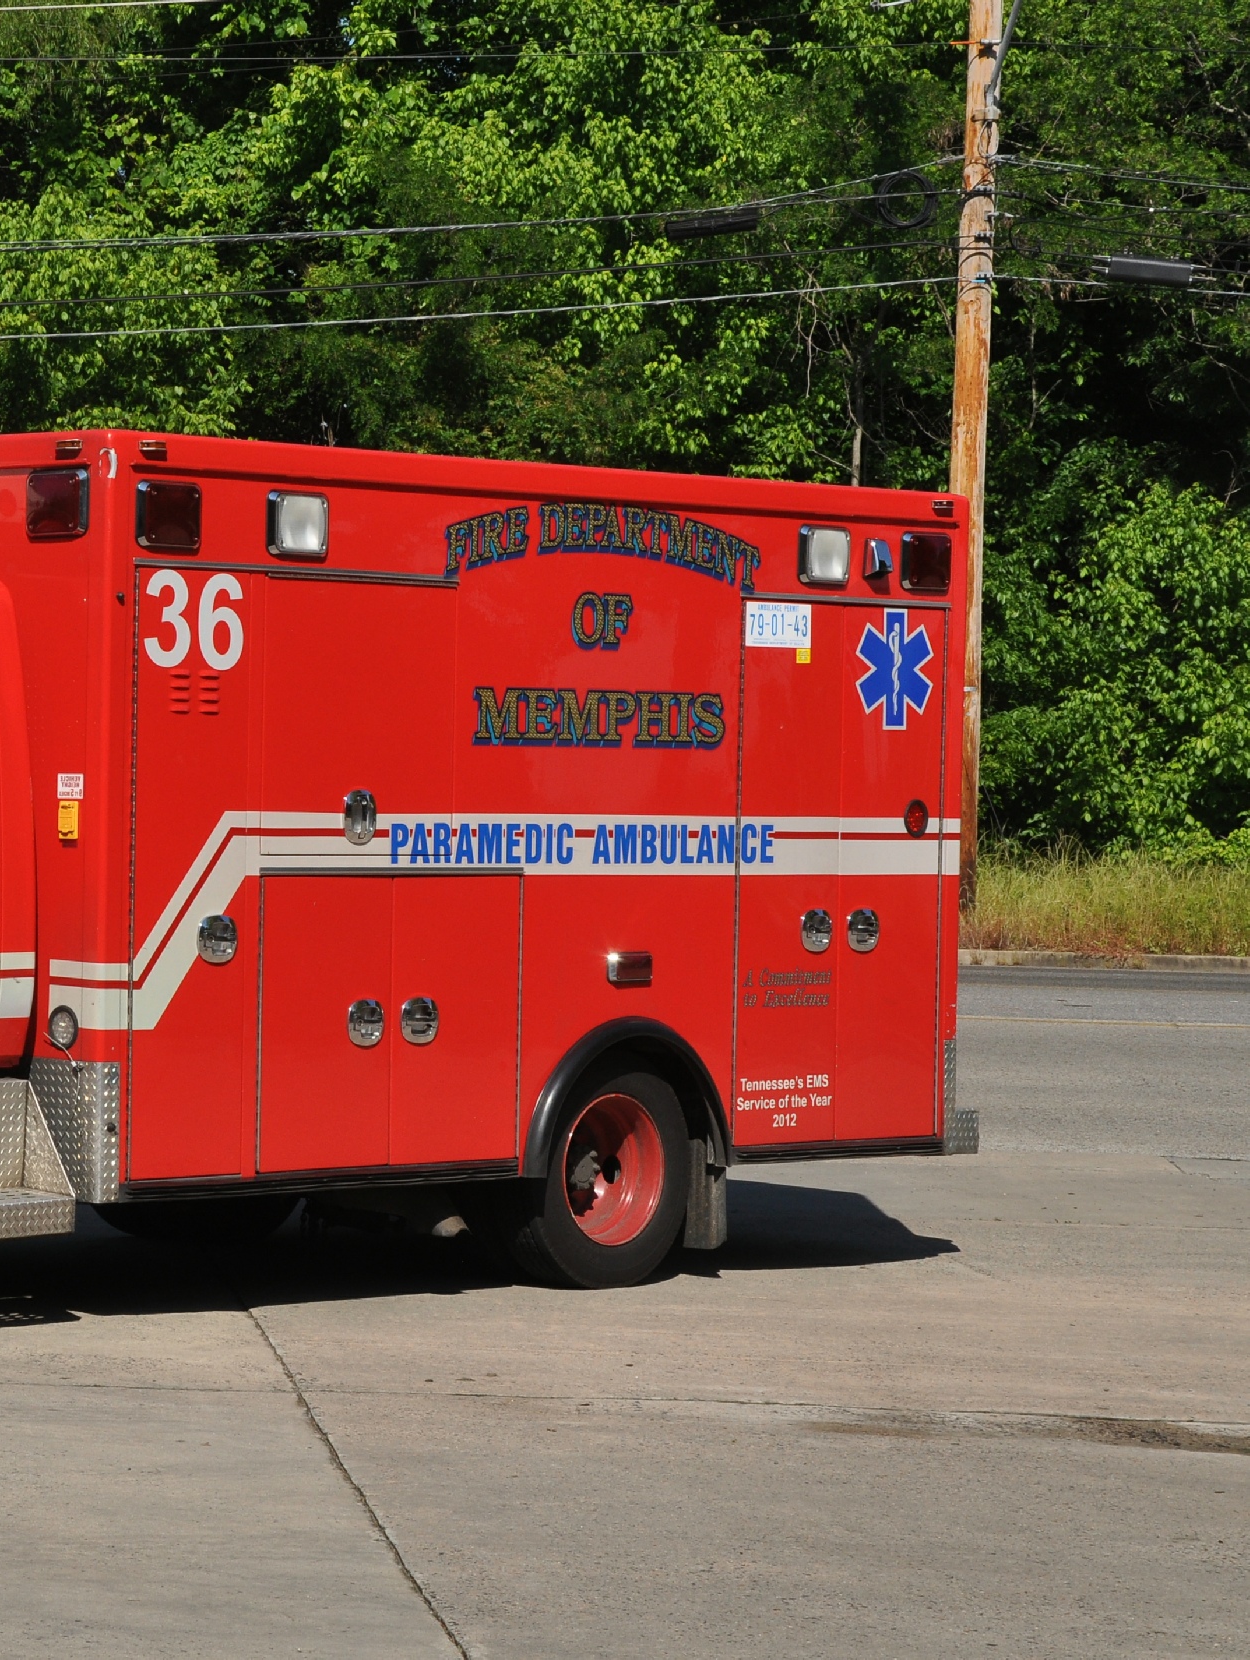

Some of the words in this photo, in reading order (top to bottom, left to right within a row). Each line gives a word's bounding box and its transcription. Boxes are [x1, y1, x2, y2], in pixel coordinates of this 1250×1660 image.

[444, 506, 529, 578] FIRE
[538, 502, 761, 594] DEPARTMENT
[144, 569, 244, 671] 36
[571, 591, 633, 650] OF
[749, 613, 808, 638] 79-01-43
[472, 687, 725, 749] MEMPHIS
[391, 823, 574, 865] PARAMEDIC
[592, 824, 775, 865] AMBULANCE
[743, 968, 753, 987] A
[759, 966, 832, 987] Commitment
[743, 993, 758, 1008] to
[763, 988, 831, 1008] Excellence
[740, 1075, 804, 1092] Tennessee's
[806, 1073, 829, 1088] EMS
[736, 1096, 776, 1111] Service
[778, 1094, 790, 1109] of
[791, 1094, 808, 1108] the
[809, 1093, 833, 1107] Year
[772, 1113, 797, 1128] 2012
